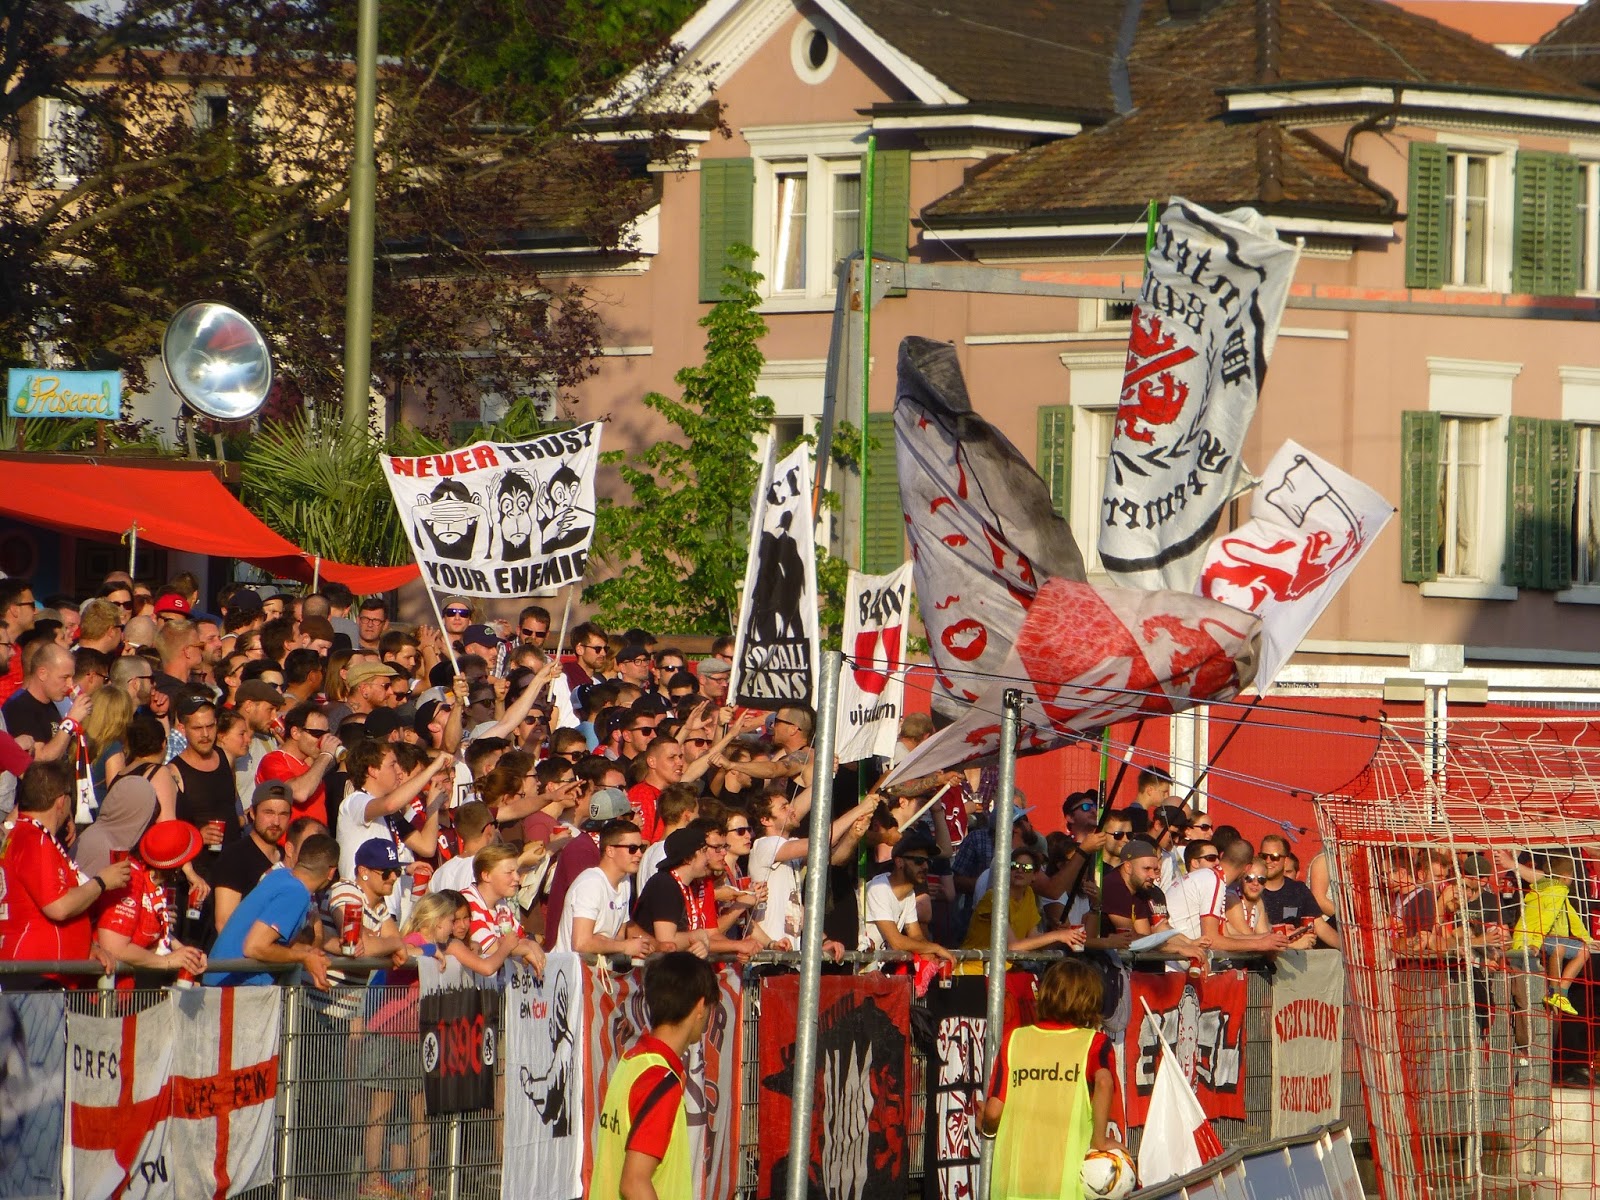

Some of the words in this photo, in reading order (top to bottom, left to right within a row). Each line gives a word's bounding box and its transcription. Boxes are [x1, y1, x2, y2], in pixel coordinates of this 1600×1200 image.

[25, 375, 108, 414] Prosecco
[390, 445, 499, 478] NEVER
[497, 423, 596, 463] TRUST
[424, 560, 491, 593] YOUR
[740, 668, 807, 700] FANS
[73, 1044, 118, 1080] DRFC
